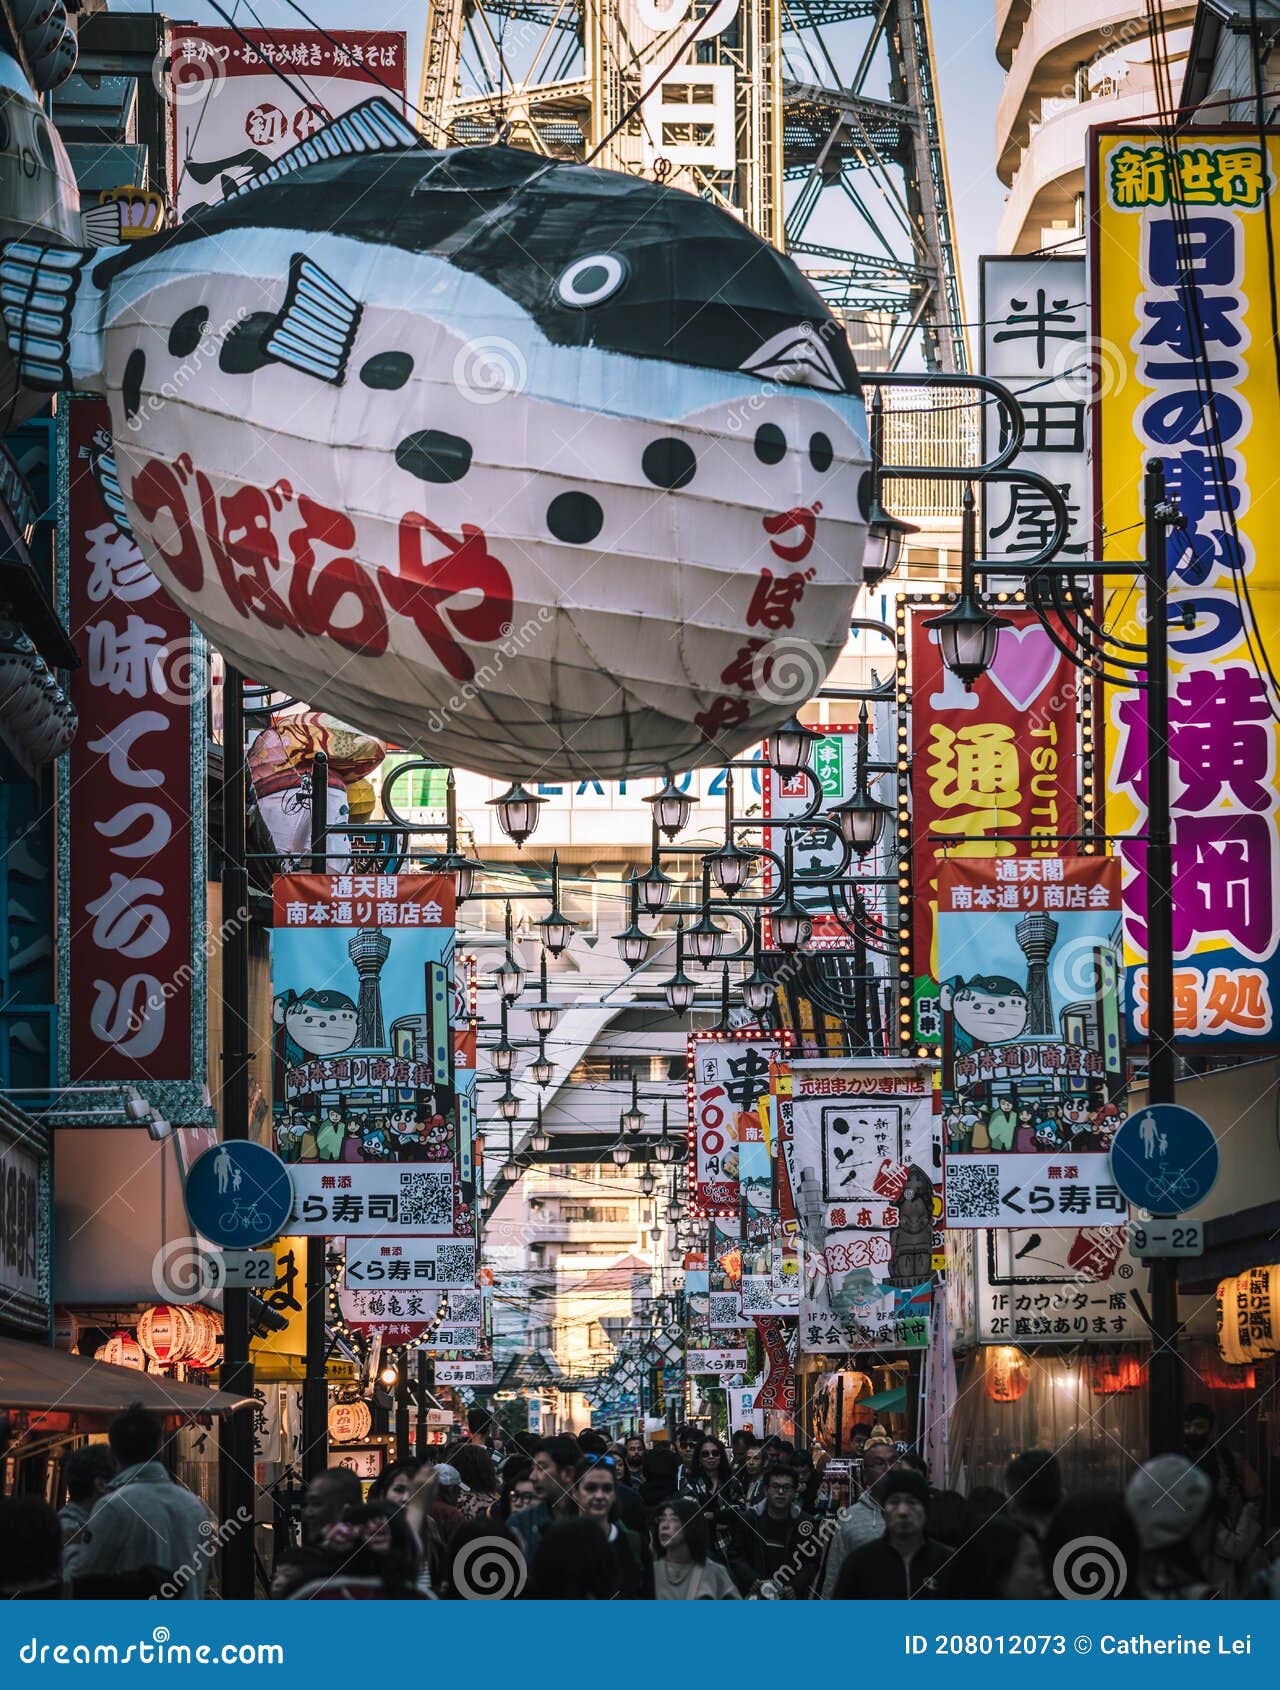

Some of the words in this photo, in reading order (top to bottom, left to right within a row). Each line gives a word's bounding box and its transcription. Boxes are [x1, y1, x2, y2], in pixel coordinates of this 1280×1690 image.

[181, 42, 398, 69] 串かつ・お好み焼き・焼きそば
[1110, 144, 1268, 209] 新世界
[989, 288, 1090, 555] 半田屋
[817, 745, 839, 792] 串かつ
[1030, 721, 1058, 858] TSUTE
[1118, 671, 1277, 953] 横綱
[995, 859, 1064, 882] 通天閣
[331, 876, 398, 899] 通天閣
[950, 884, 1110, 909] 南本通り商店会
[286, 901, 443, 924] 南本通り商店会
[1139, 971, 1270, 1034] 酒処
[799, 1077, 925, 1096] 元祖串カツ専門店
[321, 1175, 352, 1189] 無添
[1047, 1166, 1079, 1180] 無添
[291, 1194, 399, 1223] ら寿司
[1001, 1185, 1127, 1215] くら寿司
[1133, 1228, 1199, 1248] 9-22
[208, 1260, 270, 1280] 9-22
[347, 1260, 436, 1281] くら寿司
[367, 1294, 426, 1317] 鶴亀家
[807, 1324, 926, 1345] 宴会予約受付中
[435, 1371, 475, 1381] くら寿司
[704, 1359, 748, 1370] くら寿司
